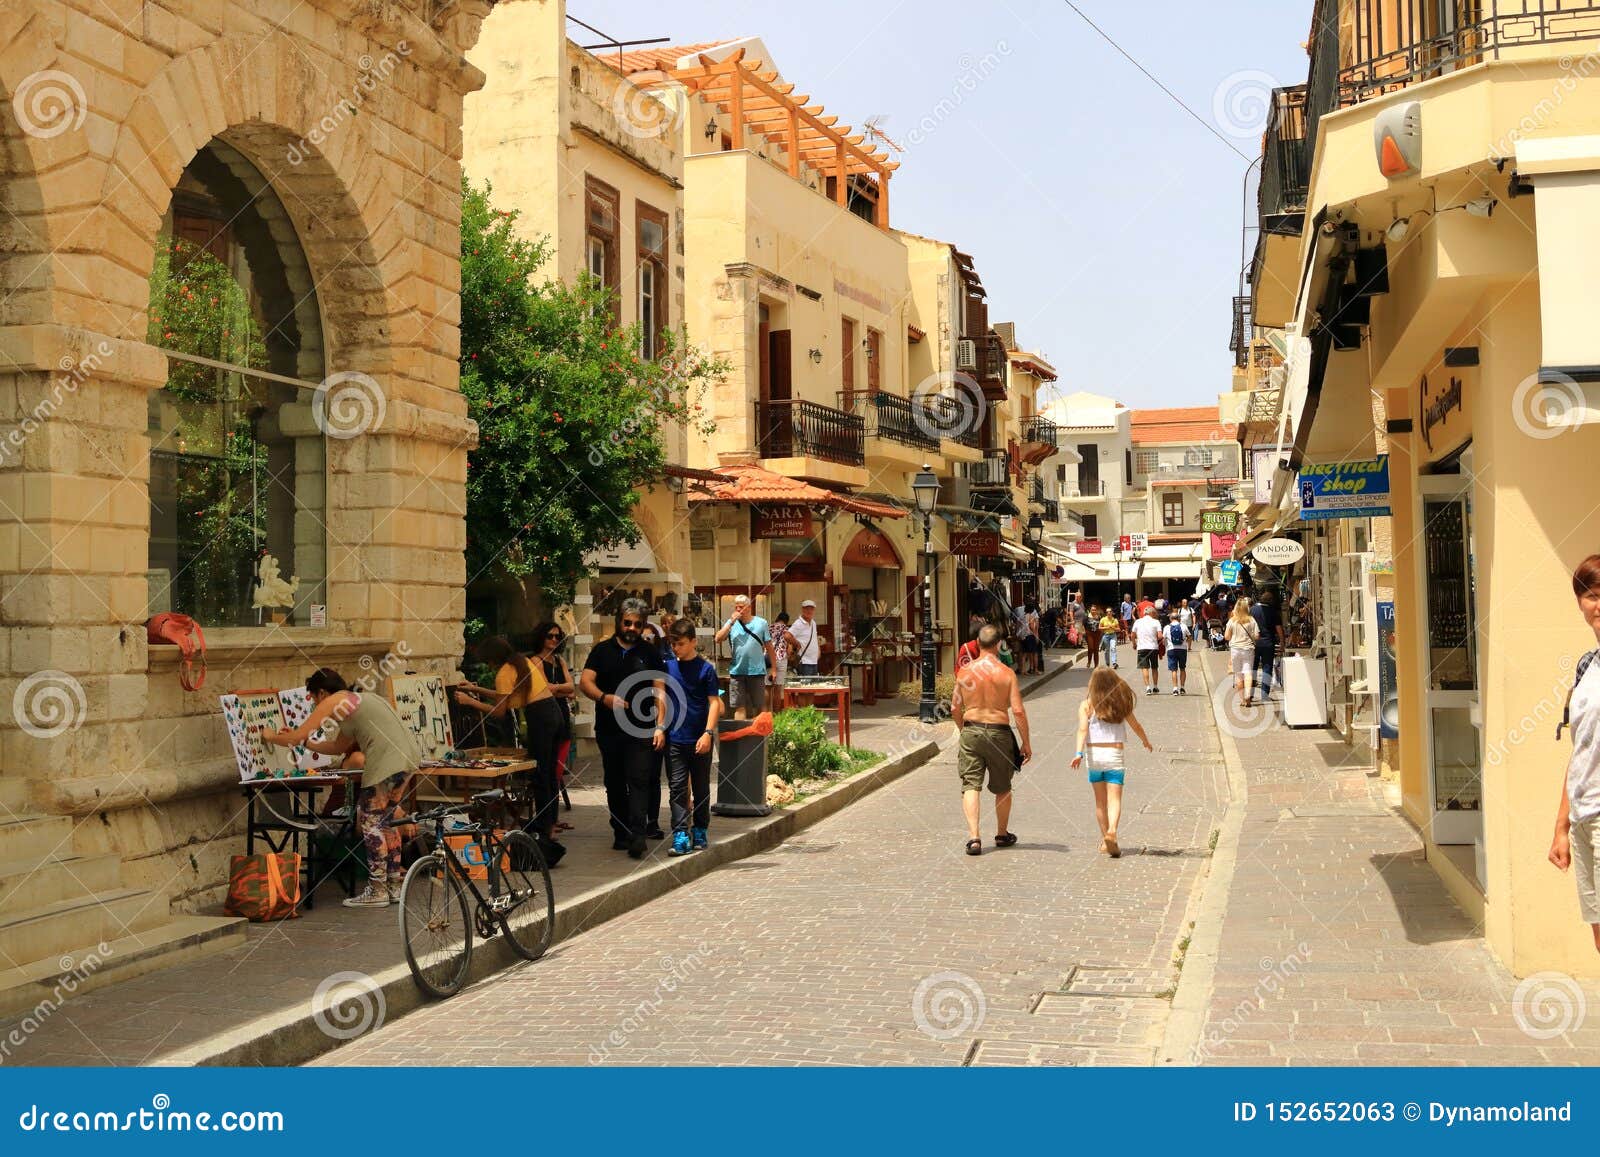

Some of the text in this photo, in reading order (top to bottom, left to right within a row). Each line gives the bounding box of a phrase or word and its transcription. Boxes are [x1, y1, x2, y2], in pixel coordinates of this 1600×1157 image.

[1300, 456, 1386, 476] electrical
[1322, 474, 1366, 494] shop
[760, 507, 803, 519] SARA
[1205, 514, 1234, 523] TIME
[1204, 523, 1233, 531] OUT
[1257, 544, 1300, 553] PANDORA
